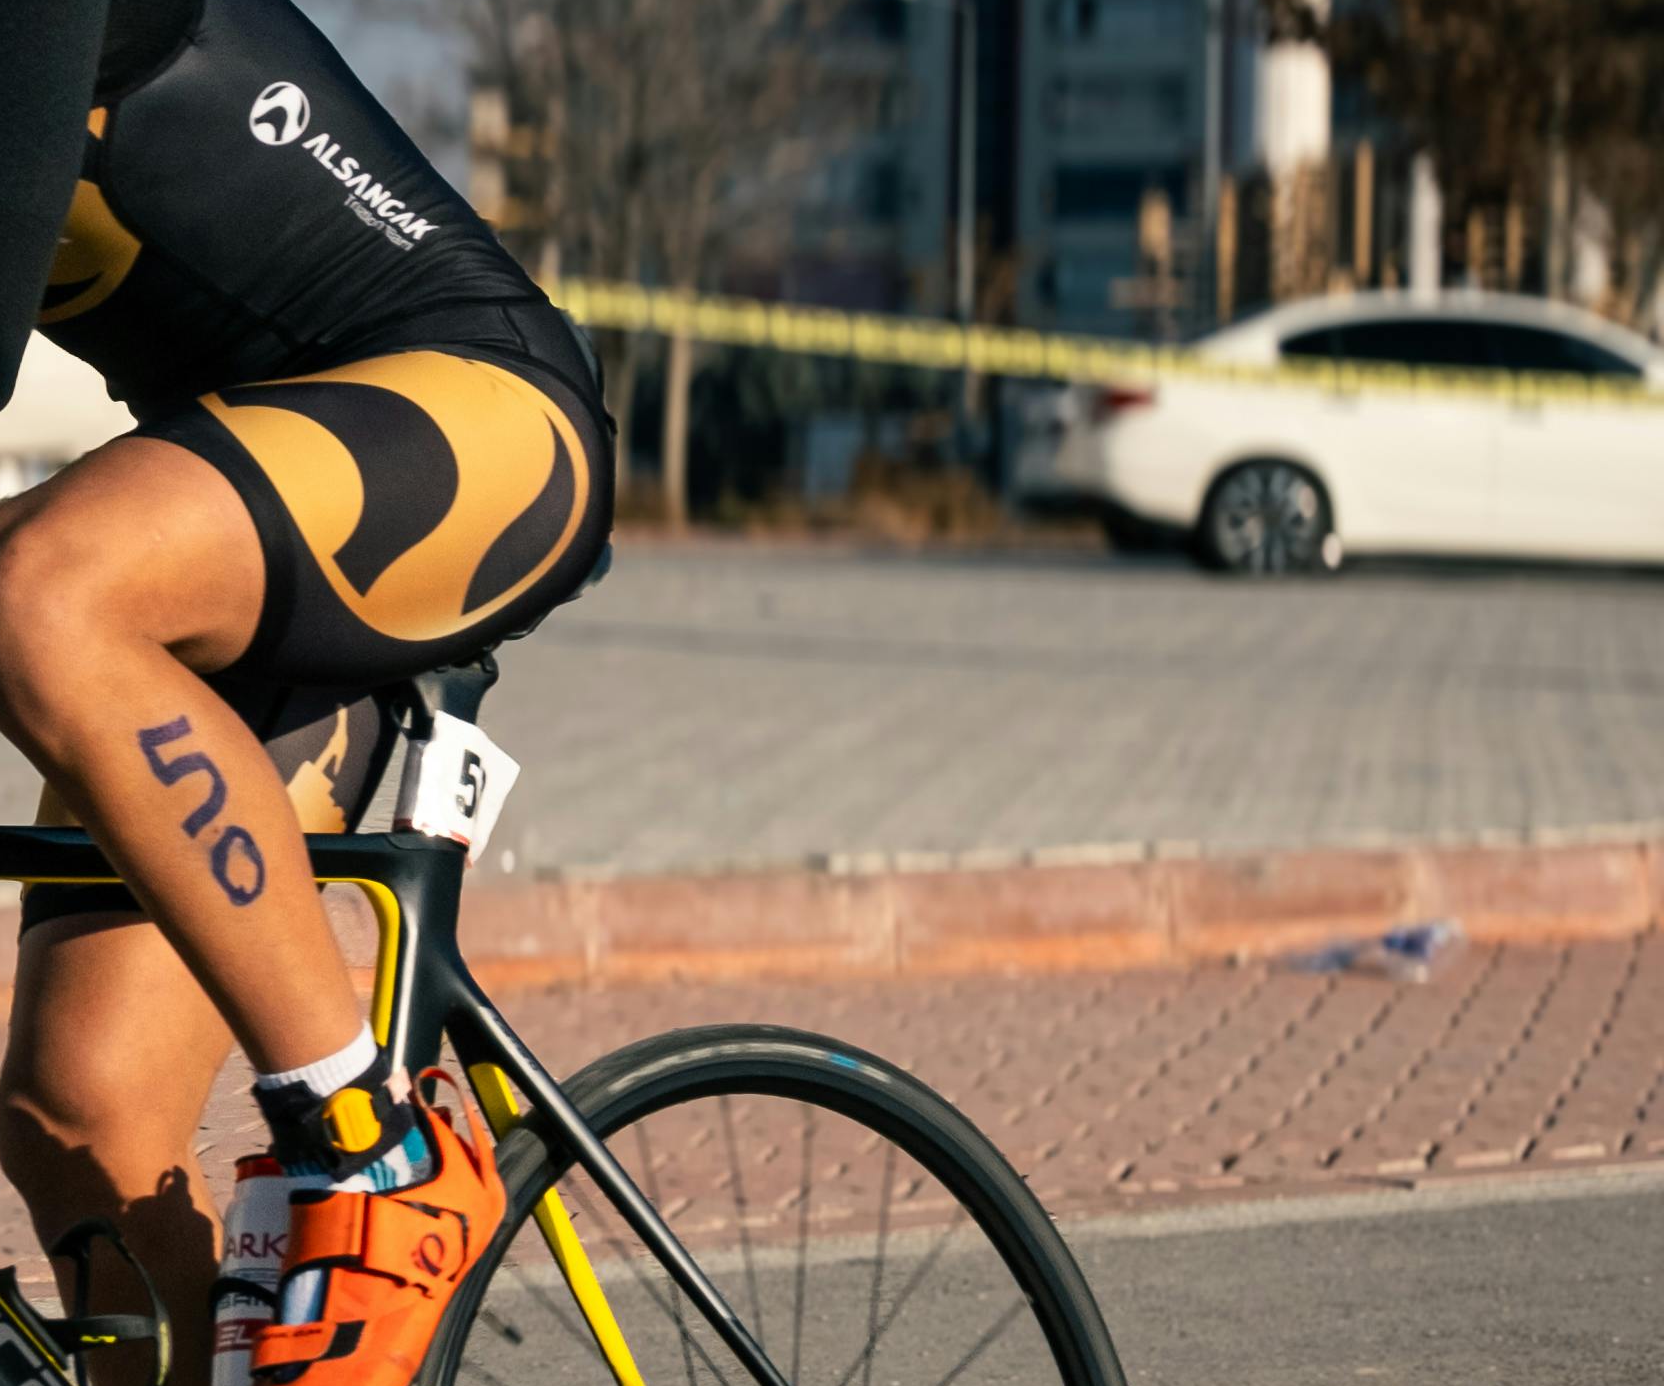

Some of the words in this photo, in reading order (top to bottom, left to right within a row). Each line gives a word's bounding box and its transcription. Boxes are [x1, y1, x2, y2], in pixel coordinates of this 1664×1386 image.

[302, 133, 440, 240] ALSANCAK
[138, 715, 266, 907] 50
[456, 749, 486, 819] 5
